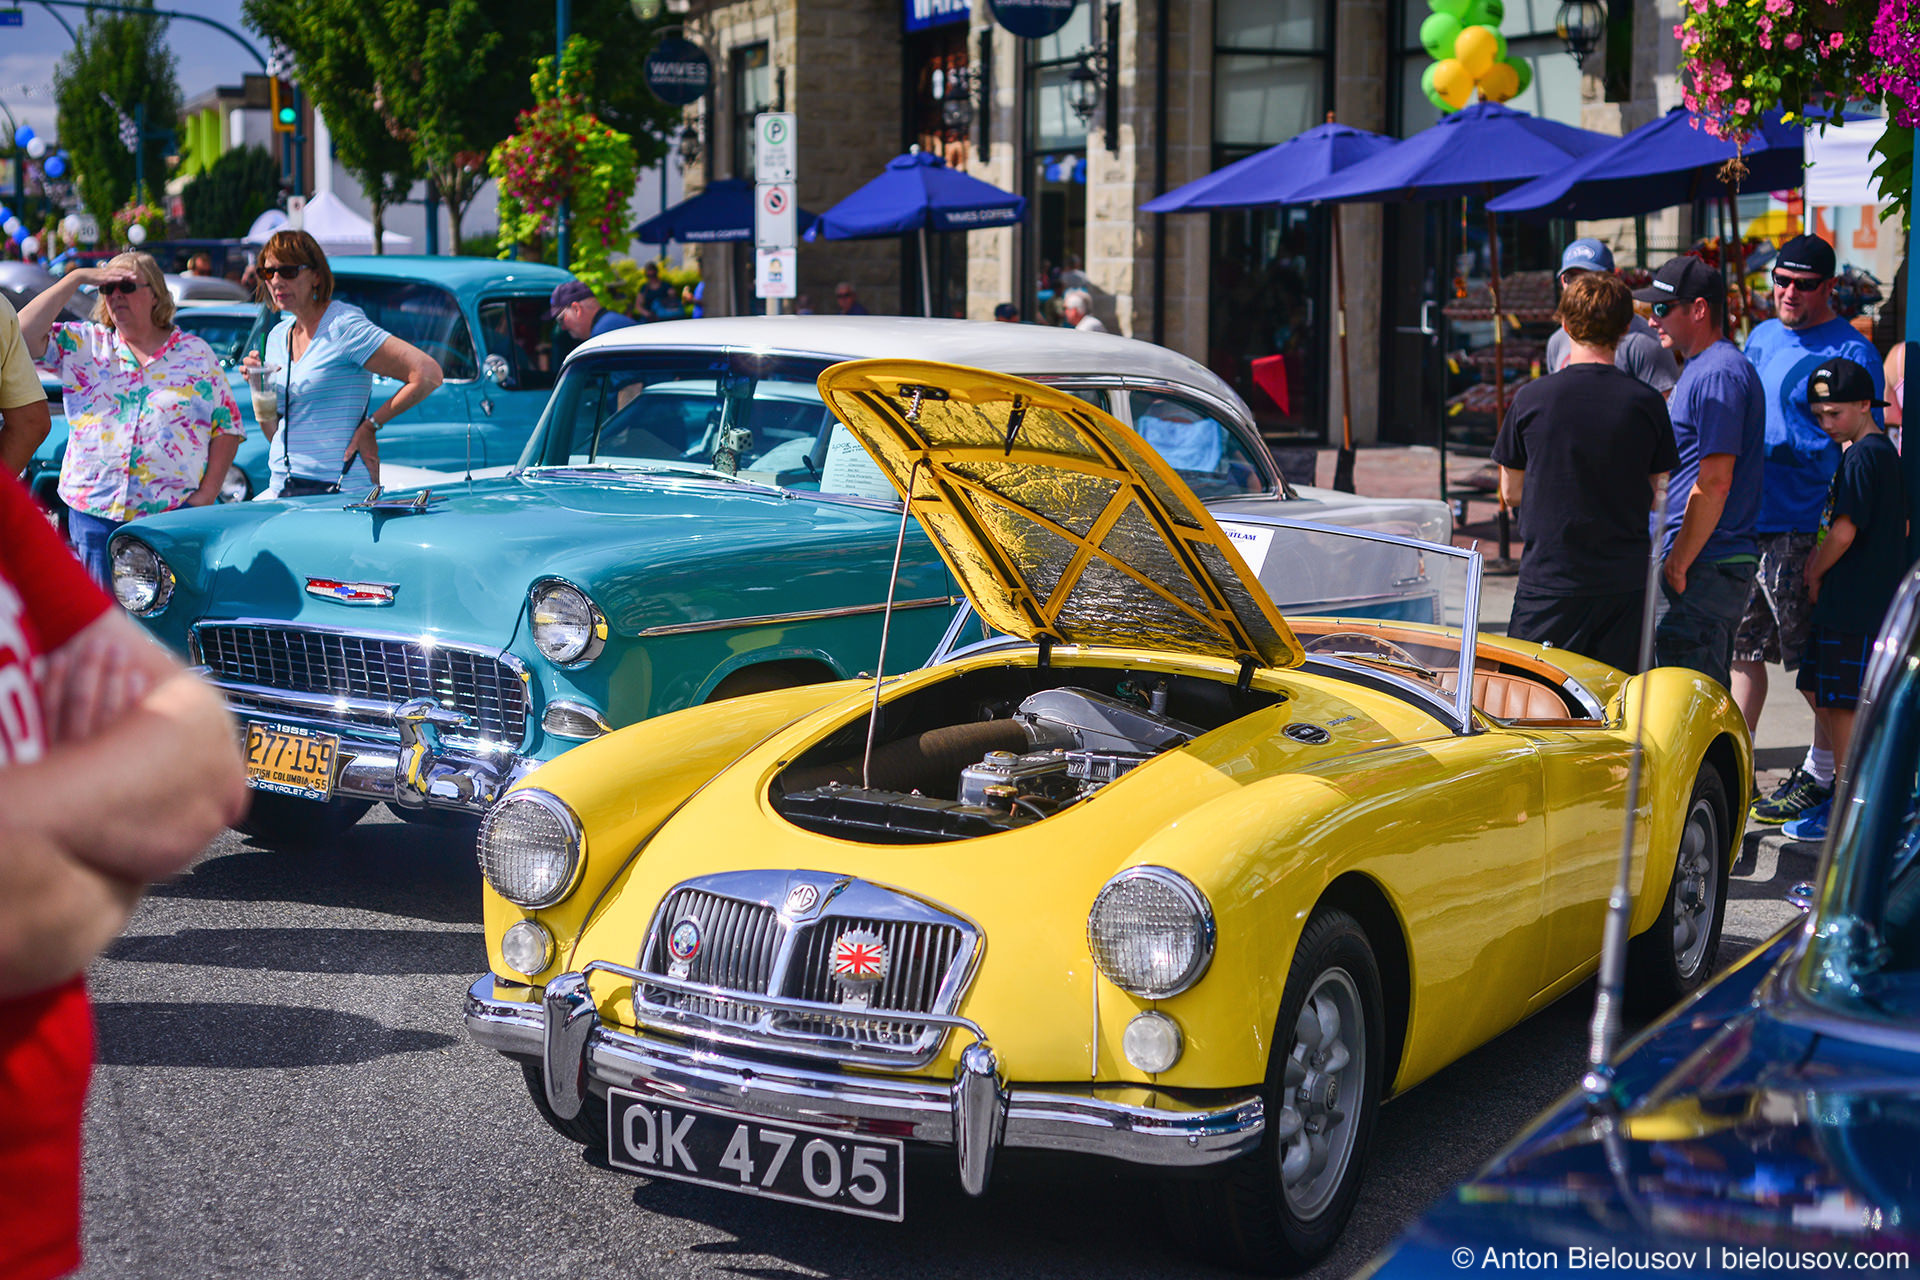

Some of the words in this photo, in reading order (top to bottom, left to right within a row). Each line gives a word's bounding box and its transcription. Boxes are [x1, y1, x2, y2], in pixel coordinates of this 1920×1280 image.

[650, 62, 706, 75] WAVES
[259, 781, 303, 796] CHEVROLET
[790, 887, 814, 908] MG
[623, 1103, 698, 1172] QK
[719, 1124, 887, 1205] 4705
